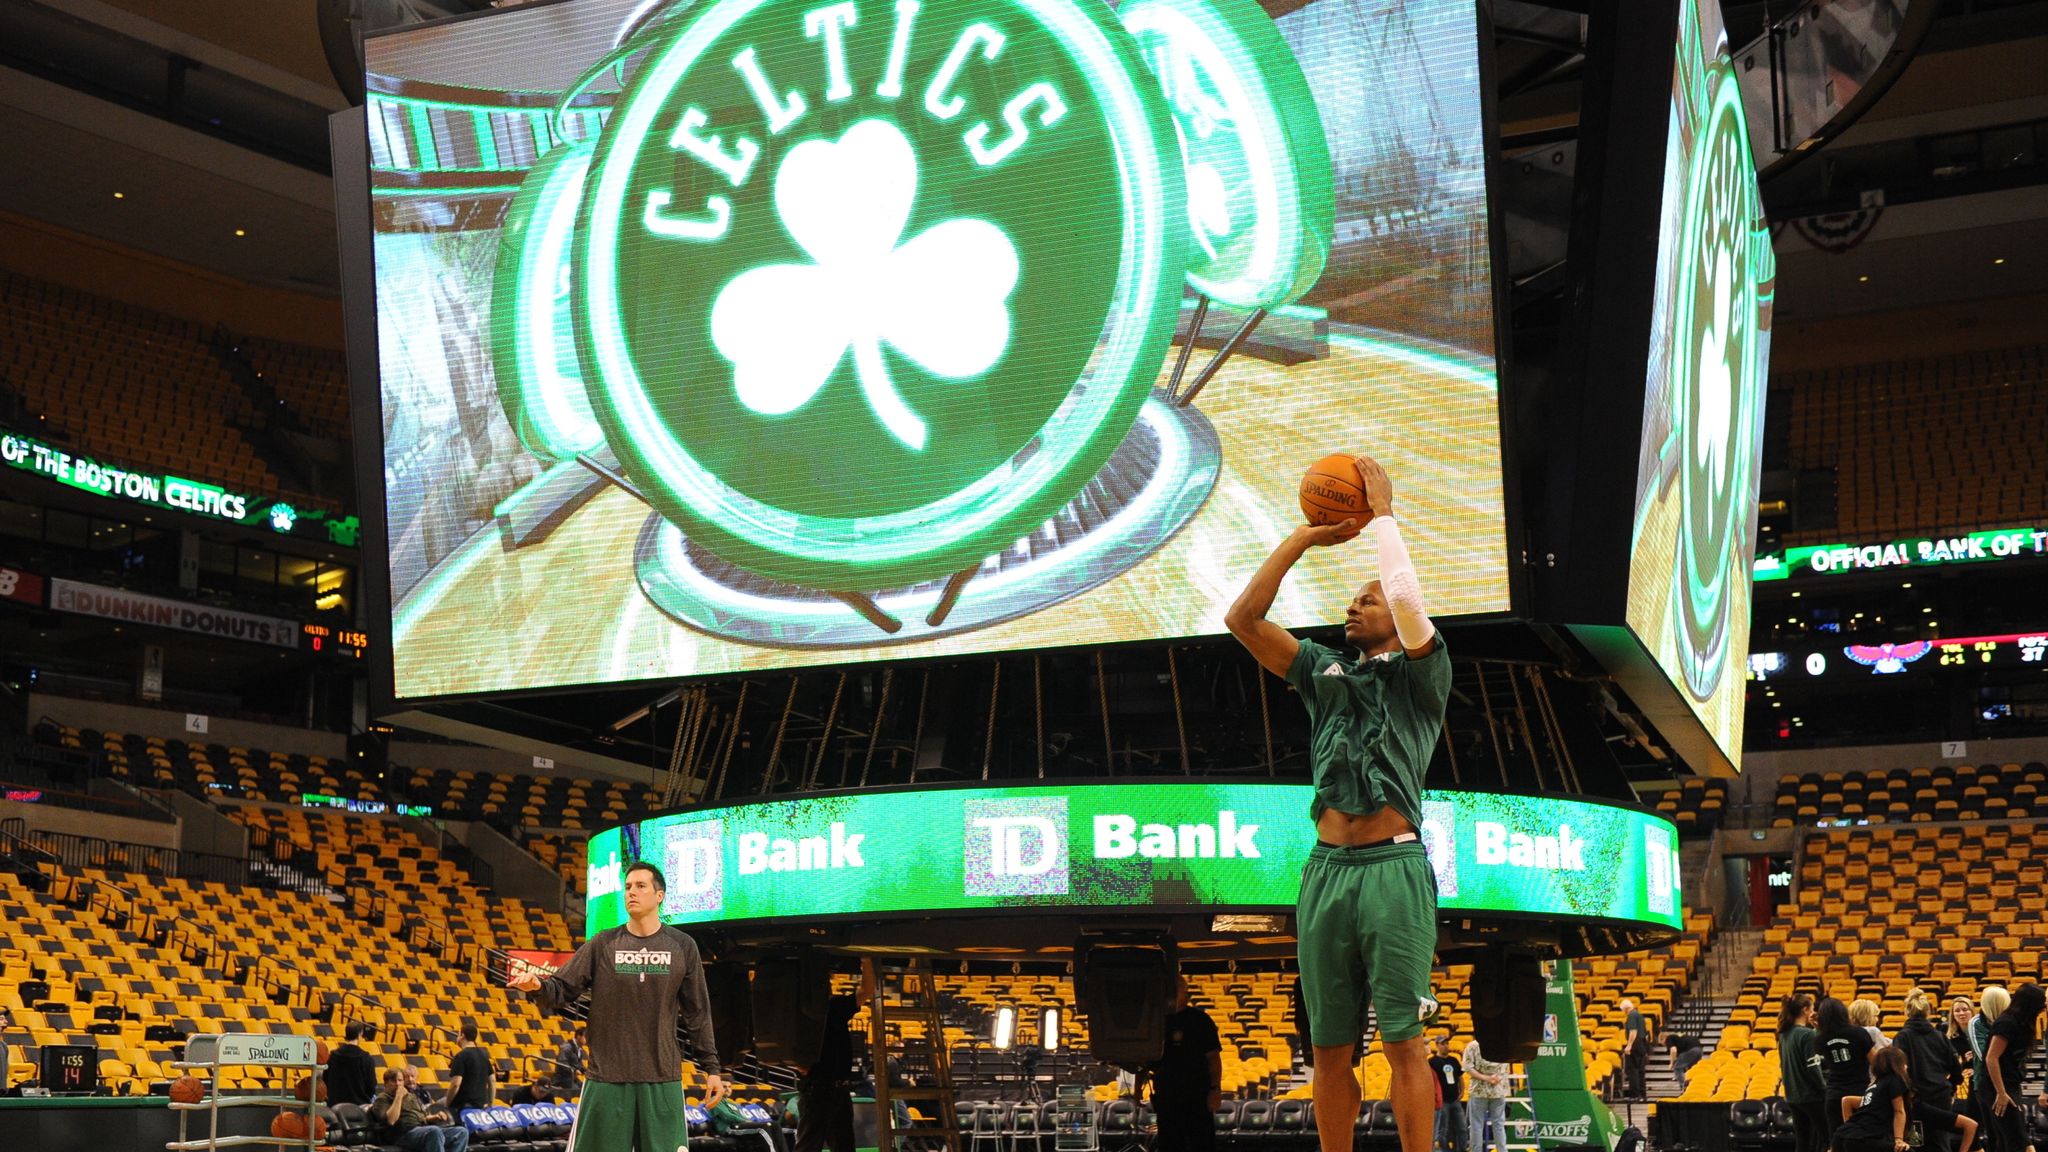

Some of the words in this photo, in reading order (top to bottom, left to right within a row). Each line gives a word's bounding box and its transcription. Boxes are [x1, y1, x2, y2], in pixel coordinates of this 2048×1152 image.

[642, 0, 1069, 241] CELTICS
[1, 436, 29, 464] OF
[33, 444, 71, 478] THE
[75, 458, 160, 502] BOSTON
[165, 482, 246, 520] CELTICS
[1304, 481, 1357, 508] SPALDING
[1811, 544, 1910, 572] OFFICIAL
[1918, 537, 1987, 561] BANK
[1991, 534, 2024, 556] OF
[2030, 530, 2048, 553] T
[75, 591, 180, 626] DUNKIN'
[181, 609, 272, 643] DONUTS
[313, 636, 321, 651] 0
[339, 631, 367, 648] 11:55
[1806, 652, 1826, 676] 0
[738, 822, 865, 875] Bank
[973, 816, 1059, 876] TD
[1093, 810, 1262, 859] Bank
[1475, 821, 1586, 871] Bank
[615, 953, 671, 965] BOSTON
[615, 964, 670, 972] BASKETBALL
[248, 1047, 290, 1061] SPALDING
[1555, 1046, 1567, 1057] TV
[65, 1067, 80, 1085] 14
